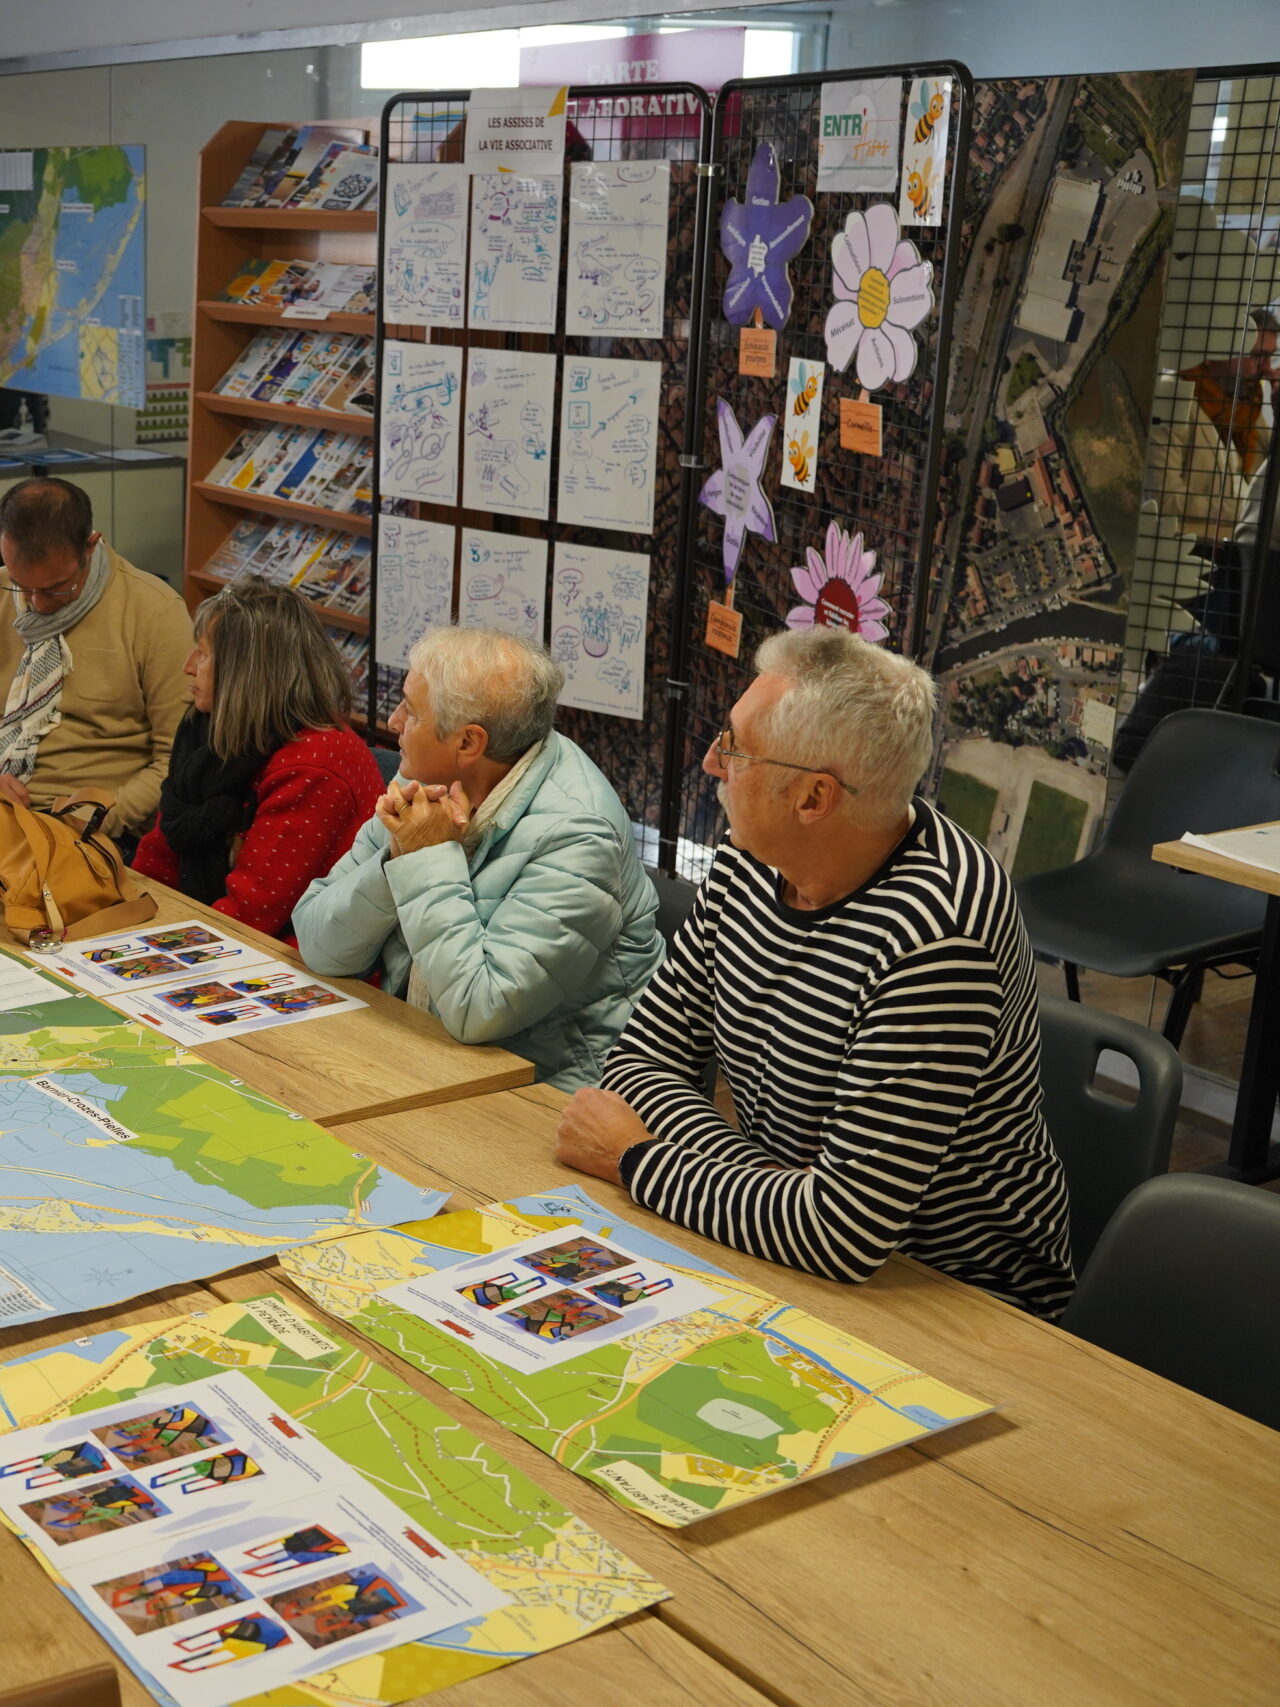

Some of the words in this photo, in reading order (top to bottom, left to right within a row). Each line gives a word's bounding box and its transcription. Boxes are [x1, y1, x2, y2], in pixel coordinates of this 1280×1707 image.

[587, 59, 659, 84] CARTE
[488, 117, 502, 128] LES
[504, 116, 532, 128] ASSISES
[534, 116, 545, 128] DE
[479, 140, 488, 150] LA
[489, 139, 504, 150] VIE
[505, 139, 553, 151] ASSOCIATIVE
[893, 292, 927, 305] Subventions
[830, 317, 856, 339] Mécénat
[36, 1079, 130, 1140] Barnier-Crozes-Pielles
